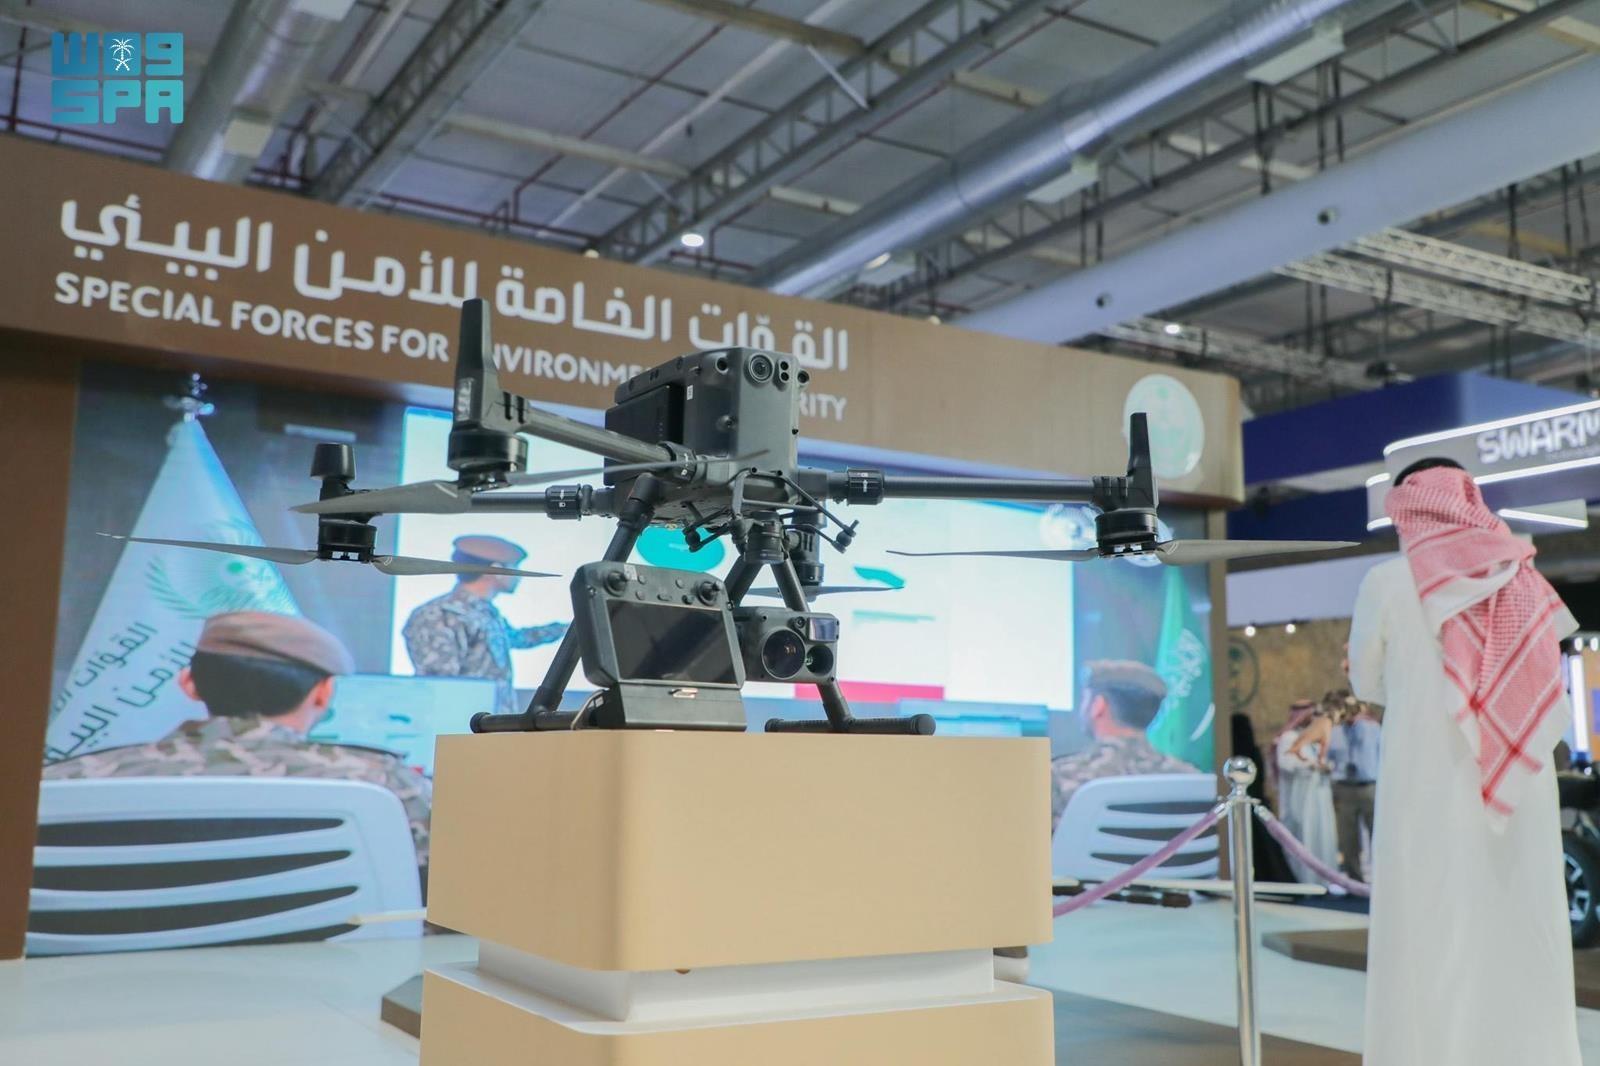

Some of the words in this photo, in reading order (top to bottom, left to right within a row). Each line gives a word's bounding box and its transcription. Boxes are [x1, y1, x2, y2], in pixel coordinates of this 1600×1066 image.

[60, 194, 273, 281] البيئي
[294, 229, 478, 309] للأمن
[54, 272, 221, 328] SPECIAL
[231, 301, 375, 350] FORCES
[381, 325, 449, 362] FOR
[496, 265, 672, 342] الخاصة
